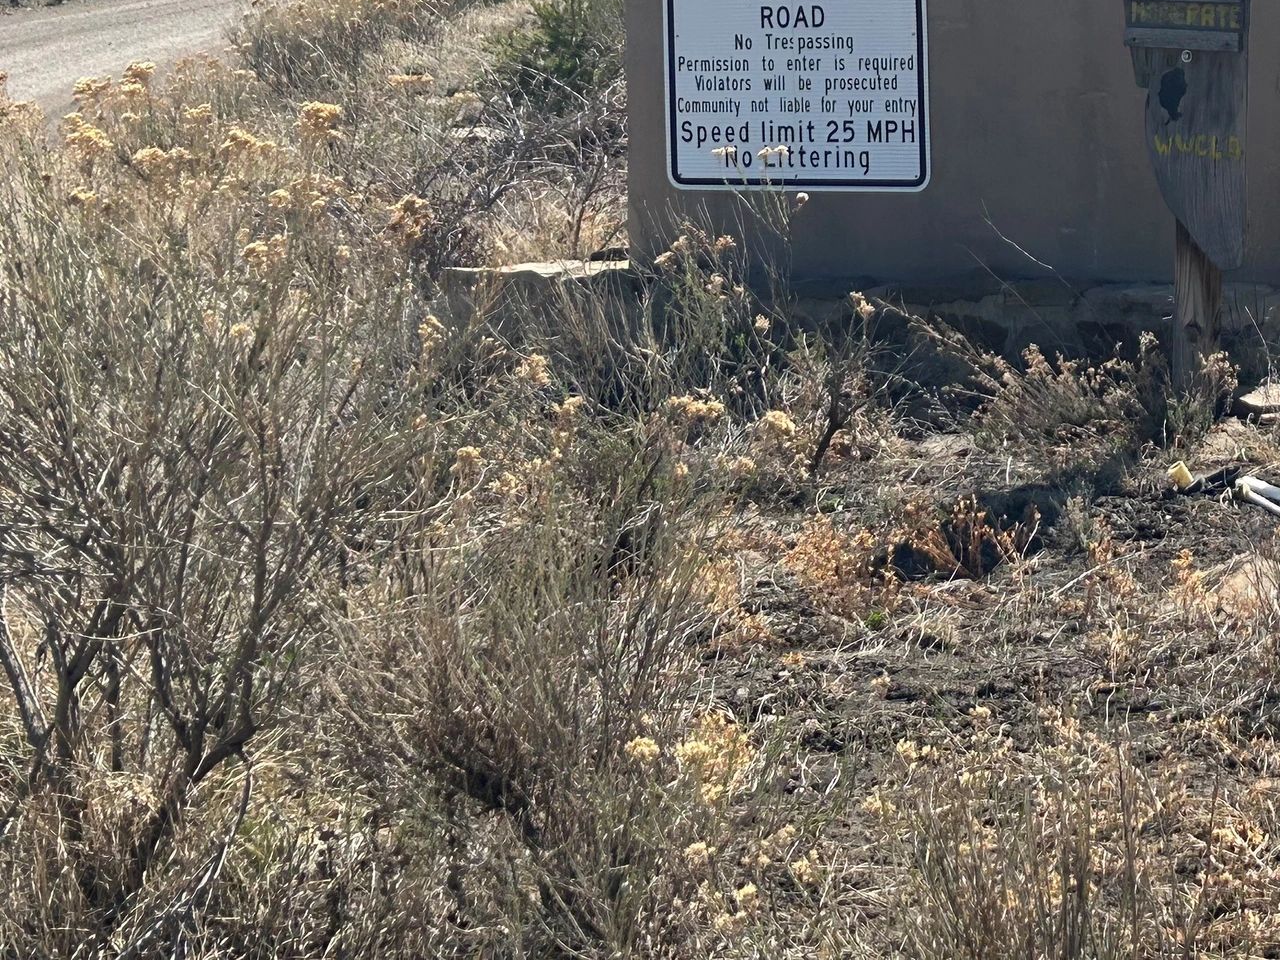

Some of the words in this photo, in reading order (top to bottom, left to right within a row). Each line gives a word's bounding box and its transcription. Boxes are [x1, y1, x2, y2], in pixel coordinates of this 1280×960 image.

[761, 6, 825, 28] ROAD
[735, 34, 752, 50] No
[766, 33, 854, 54] Trespassing
[678, 56, 749, 72] Permission
[762, 57, 774, 71] to
[787, 56, 821, 71] enter
[835, 56, 845, 70] is
[859, 56, 913, 76] required
[695, 75, 751, 90] Violators
[764, 75, 785, 90] will
[799, 75, 811, 90] be
[826, 74, 897, 94] prosecuted
[678, 97, 740, 116] Community
[751, 98, 768, 112] not
[780, 97, 810, 112] liable
[821, 97, 836, 112] for
[849, 99, 874, 116] your
[885, 98, 916, 116] entry
[681, 121, 749, 148] Speed
[762, 121, 814, 142] limit
[827, 120, 855, 142] 25
[868, 120, 915, 142] MPH
[725, 145, 752, 168] No
